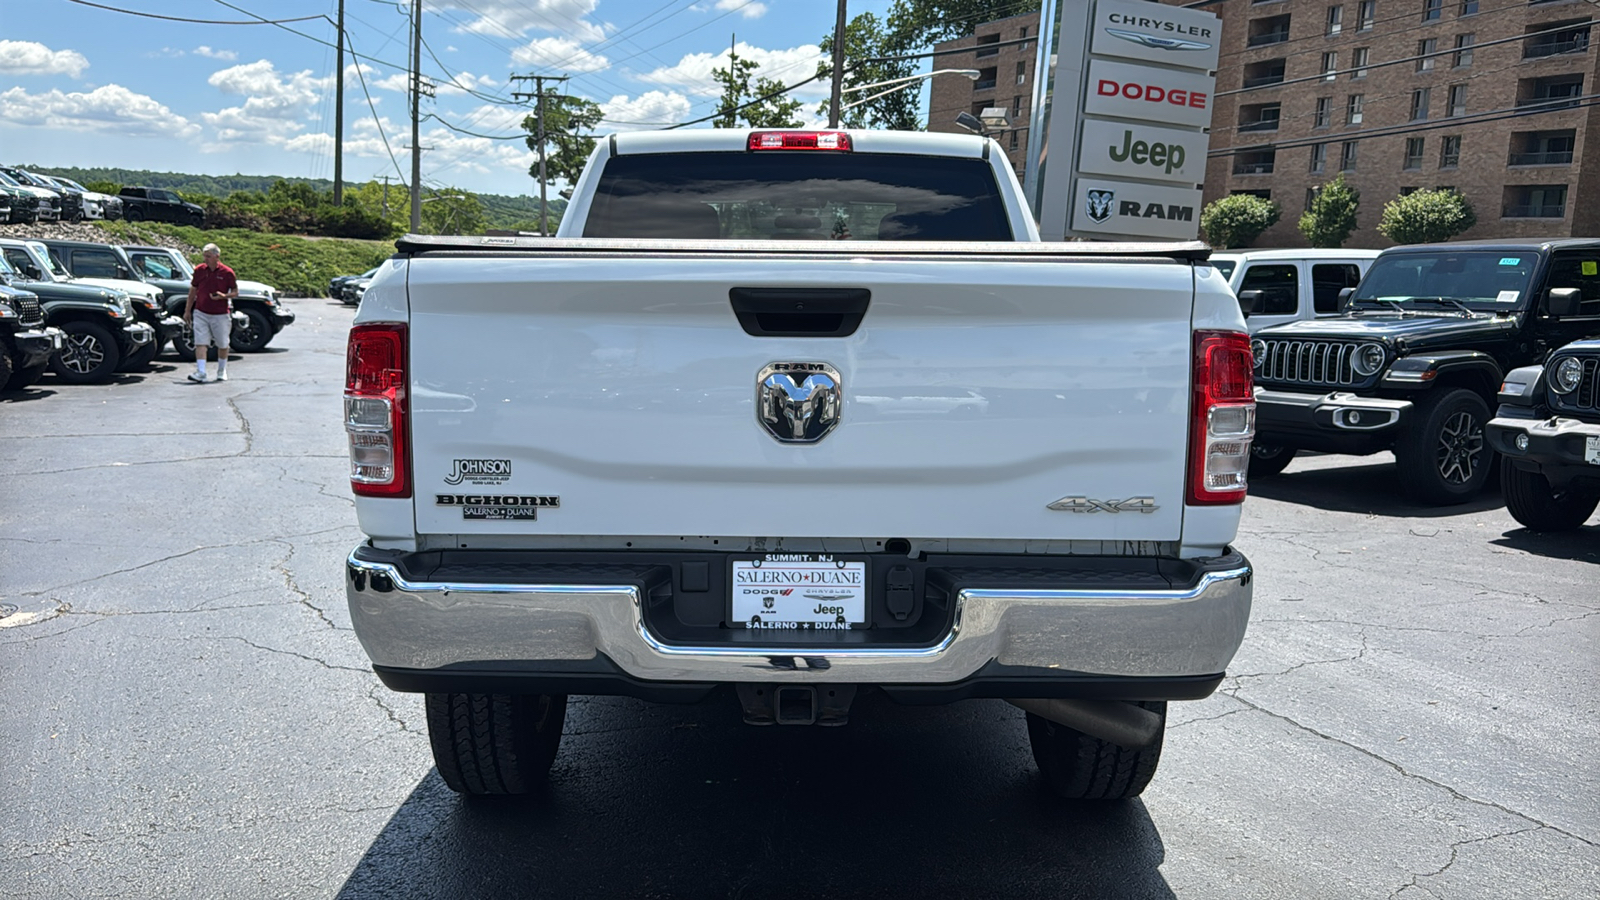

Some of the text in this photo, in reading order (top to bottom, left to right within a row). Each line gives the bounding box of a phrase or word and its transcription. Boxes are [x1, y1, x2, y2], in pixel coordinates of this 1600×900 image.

[1108, 13, 1212, 39] CHRYSLER
[1097, 79, 1207, 109] DODGE
[1109, 130, 1185, 174] Jeep
[1119, 200, 1193, 222] RAM
[774, 363, 824, 371] RAM
[444, 459, 511, 485] JOHNSON
[436, 494, 559, 507] BIGHORN
[464, 508, 534, 516] SALERNO DUANE
[818, 554, 834, 562] NJ
[737, 571, 861, 584] SALERNO DUANE
[814, 604, 844, 616] Jeep
[745, 622, 852, 630] SALERNO DUANE
